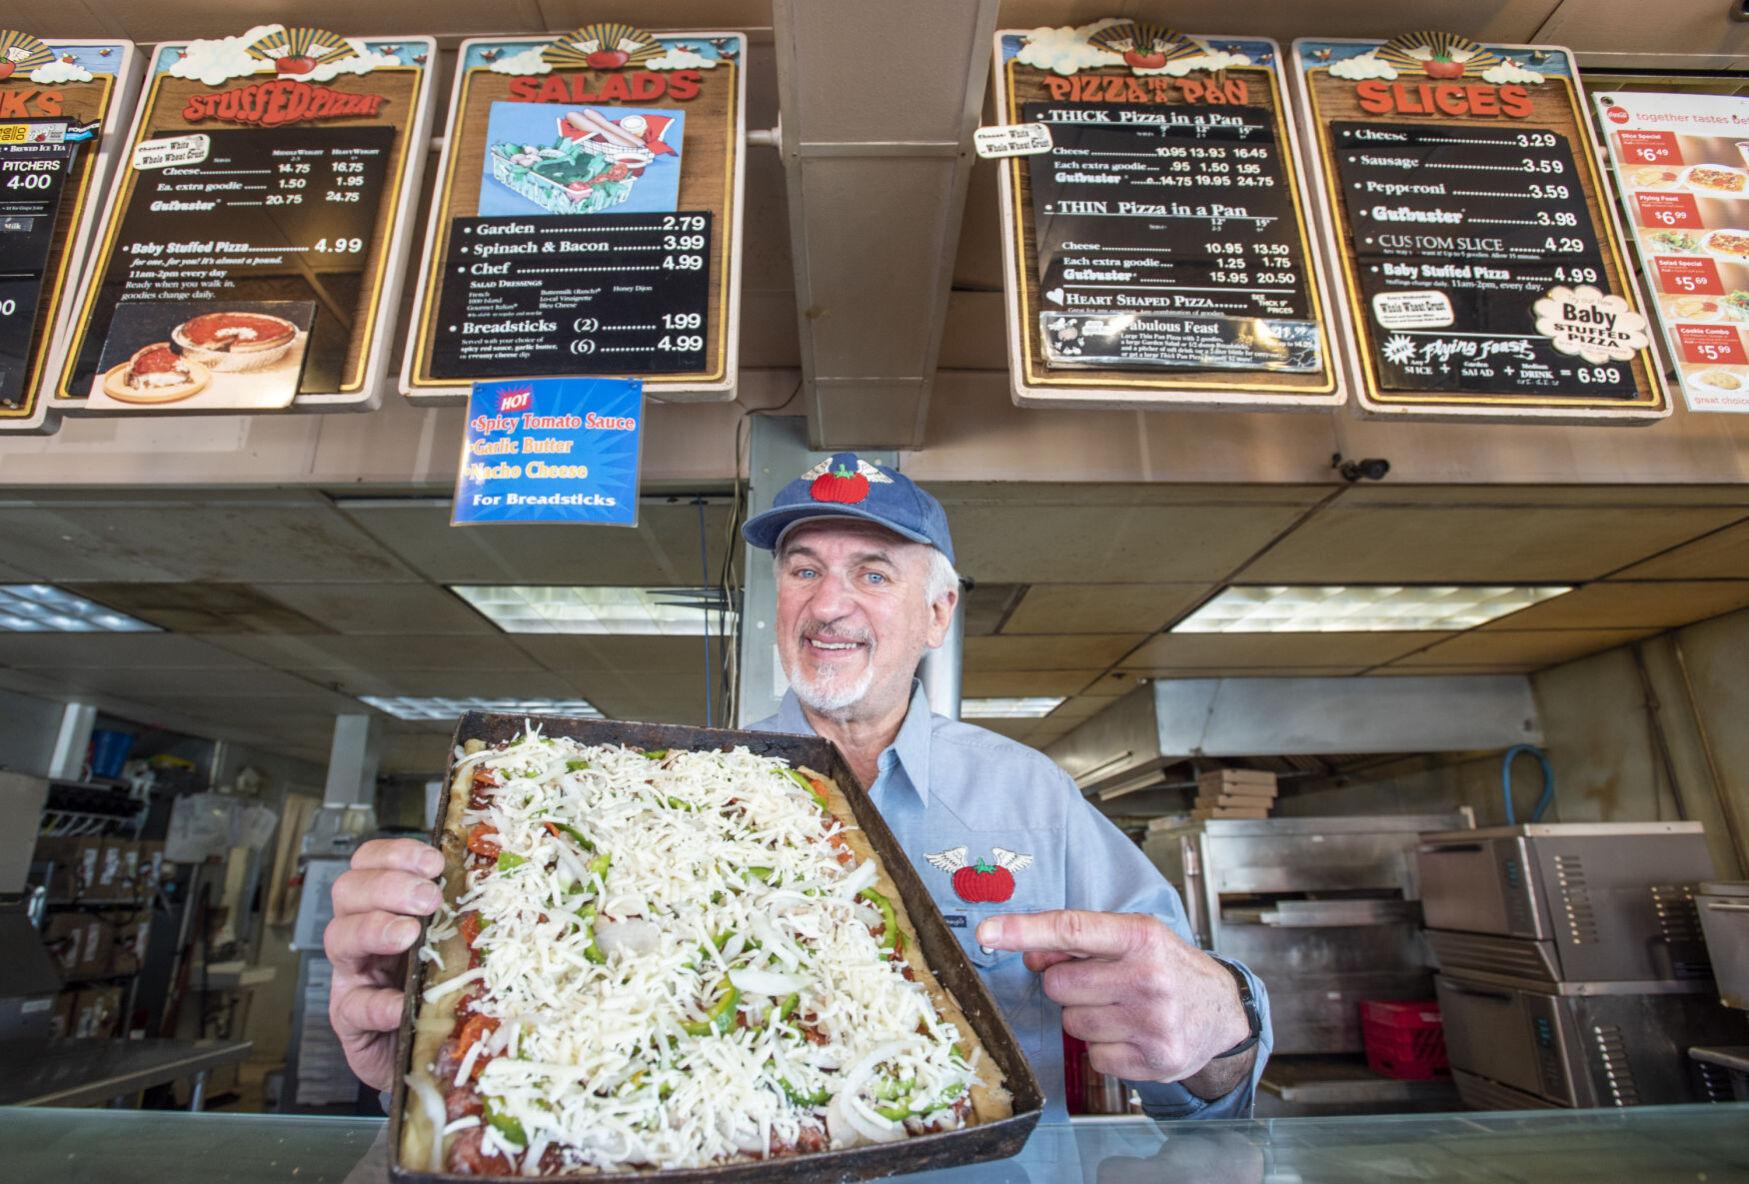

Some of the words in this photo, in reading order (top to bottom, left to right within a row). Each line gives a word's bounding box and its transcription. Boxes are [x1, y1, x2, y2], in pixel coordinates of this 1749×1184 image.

[506, 69, 702, 103] SALADS
[1043, 75, 1148, 103] PIZZA
[1176, 78, 1249, 105] PAN
[1356, 79, 1534, 118] SLICES
[1048, 110, 1110, 122] THICK
[1119, 111, 1166, 123] Pizza
[1170, 112, 1190, 124] in
[1194, 115, 1206, 125] a
[1209, 114, 1243, 126] Pan
[1636, 112, 1689, 123] together
[1692, 114, 1729, 124] tastes
[1355, 129, 1408, 140] Cheese
[1517, 134, 1557, 147] 3.29
[1052, 147, 1090, 155] Cheese
[2, 160, 61, 171] PITCHERS
[162, 168, 200, 176] Cheese
[278, 163, 311, 174] 14.75
[331, 162, 364, 172] 16.75
[1054, 161, 1080, 169] Each
[1111, 162, 1147, 171] goodie
[1200, 163, 1230, 173] 1.50
[1237, 164, 1261, 174] 1.95
[1360, 154, 1420, 169] Sausage
[1522, 158, 1563, 173] 3.59
[7, 174, 51, 189] 4.00
[205, 182, 243, 192] goodie
[279, 179, 306, 189] 1.50
[336, 176, 364, 186] 1.95
[1160, 176, 1192, 187] 14.75
[1195, 175, 1231, 186] 19.95
[1237, 176, 1274, 187] 24.75
[265, 194, 302, 205] 20.75
[325, 191, 360, 202] 24.75
[1366, 181, 1447, 196] Pepperoni
[1528, 184, 1569, 199] 3.59
[1057, 200, 1107, 213] THIN
[1118, 201, 1167, 215] Pizza
[1171, 202, 1192, 215] in
[1196, 205, 1207, 216] a
[1210, 204, 1248, 217] Pan
[476, 222, 536, 236] Garden
[663, 216, 706, 231] 2.79
[1537, 212, 1578, 226] 3.98
[131, 243, 163, 256] Baby
[166, 241, 212, 254] Stuffed
[215, 241, 249, 253] Pizza
[314, 238, 363, 253] 4.99
[473, 242, 538, 258] Spinach
[541, 242, 555, 253] &
[559, 241, 609, 252] Bacon
[663, 235, 705, 250] 3.99
[1062, 241, 1101, 250] Cheese
[1205, 243, 1244, 254] 10.95
[1252, 244, 1290, 255] 13.50
[1378, 234, 1454, 250] CUSTOM
[1456, 237, 1504, 251] SLICE
[1545, 237, 1584, 253] 4.29
[471, 262, 512, 275] Chef
[662, 254, 703, 270] 4.99
[1063, 257, 1090, 266] Each
[1092, 258, 1121, 266] extra
[1123, 258, 1160, 267] goodie
[1216, 258, 1246, 269] 1.25
[1262, 257, 1291, 268] 1.75
[180, 271, 208, 279] every
[209, 269, 228, 278] day
[1209, 272, 1249, 284] 15.95
[1256, 273, 1296, 284] 20.50
[1383, 263, 1418, 280] Baby
[1421, 264, 1471, 279] Stuffed
[1473, 266, 1510, 280] Pizza
[1554, 266, 1597, 283] 4.99
[126, 281, 152, 289] Ready
[154, 280, 179, 288] when
[180, 281, 199, 289] you
[200, 280, 222, 288] walk
[1500, 283, 1523, 291] every
[1525, 282, 1544, 292] day.
[121, 291, 156, 300] goodies
[158, 290, 191, 299] change
[192, 290, 216, 299] daily.
[1066, 293, 1113, 305] HEART
[1116, 294, 1170, 306] SHAPED
[462, 319, 558, 334] Breadsticks
[573, 318, 599, 333] (2)
[662, 313, 702, 330] 1.99
[1563, 303, 1616, 332] Baby
[1124, 319, 1181, 333] abulous
[1184, 321, 1219, 334] Feast
[1553, 323, 1631, 341] STUFFED
[570, 338, 596, 354] (6)
[657, 335, 703, 352] 4.99
[1568, 334, 1620, 348] PIZZA
[1520, 370, 1554, 379] DRINK
[1577, 368, 1621, 384] 6.99
[501, 393, 531, 411] HOT
[523, 412, 581, 430] Tomato
[585, 411, 636, 431] Sauce
[522, 437, 573, 454] Butter
[526, 461, 588, 479] Cheese
[472, 494, 502, 506] For
[506, 493, 616, 507] Breadsticks
